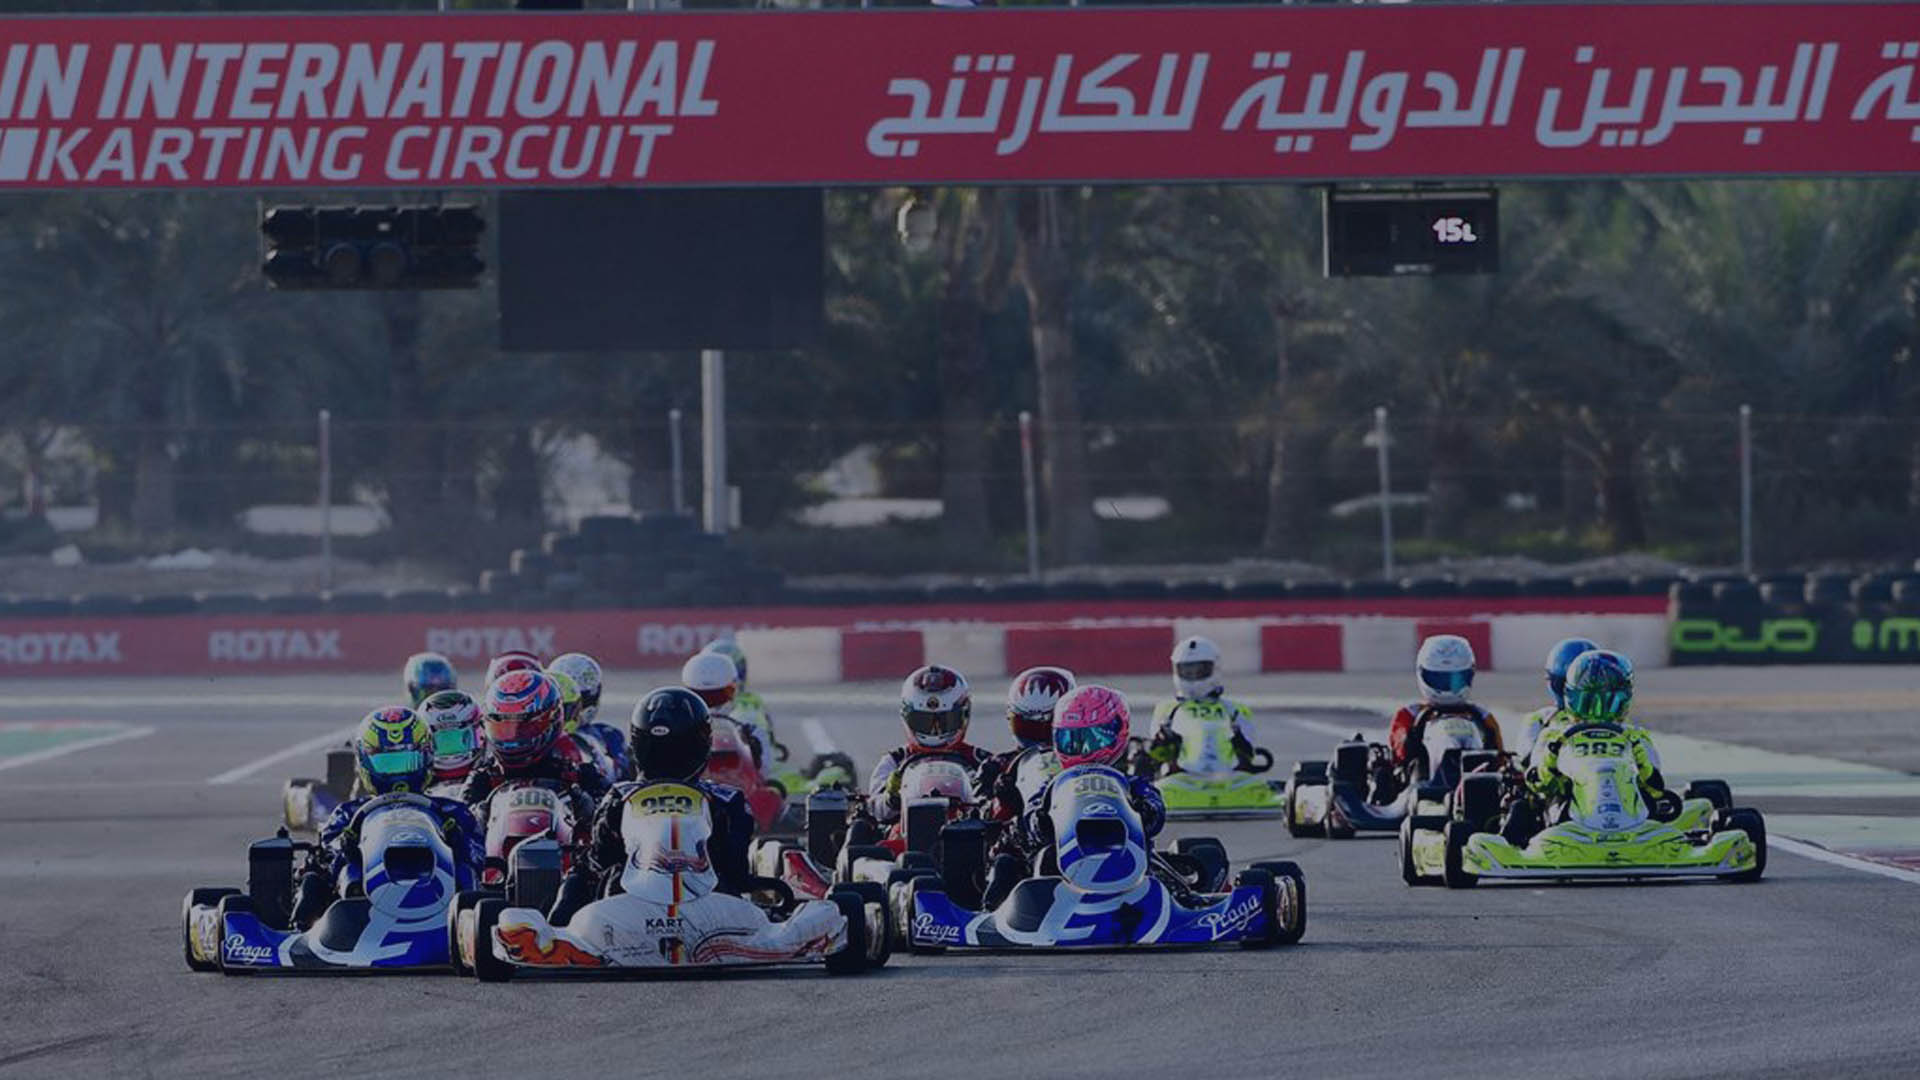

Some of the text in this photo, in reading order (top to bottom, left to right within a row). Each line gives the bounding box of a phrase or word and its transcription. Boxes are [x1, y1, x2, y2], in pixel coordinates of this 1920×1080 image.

[96, 40, 719, 120] INTERNATIONAL
[1535, 42, 1838, 147] البحرين
[866, 52, 1210, 157] للكارتنج
[1221, 47, 1526, 152] الدولية
[36, 124, 673, 181] KARTING CIRCUIT
[0, 631, 122, 663] ROTAX
[208, 629, 341, 660] ROTAX
[426, 626, 555, 656] ROTAX
[637, 623, 768, 655] ROT
[646, 918, 684, 928] KART
[914, 914, 960, 940] Praga
[1200, 893, 1262, 939] Praga
[224, 934, 273, 963] Praga
